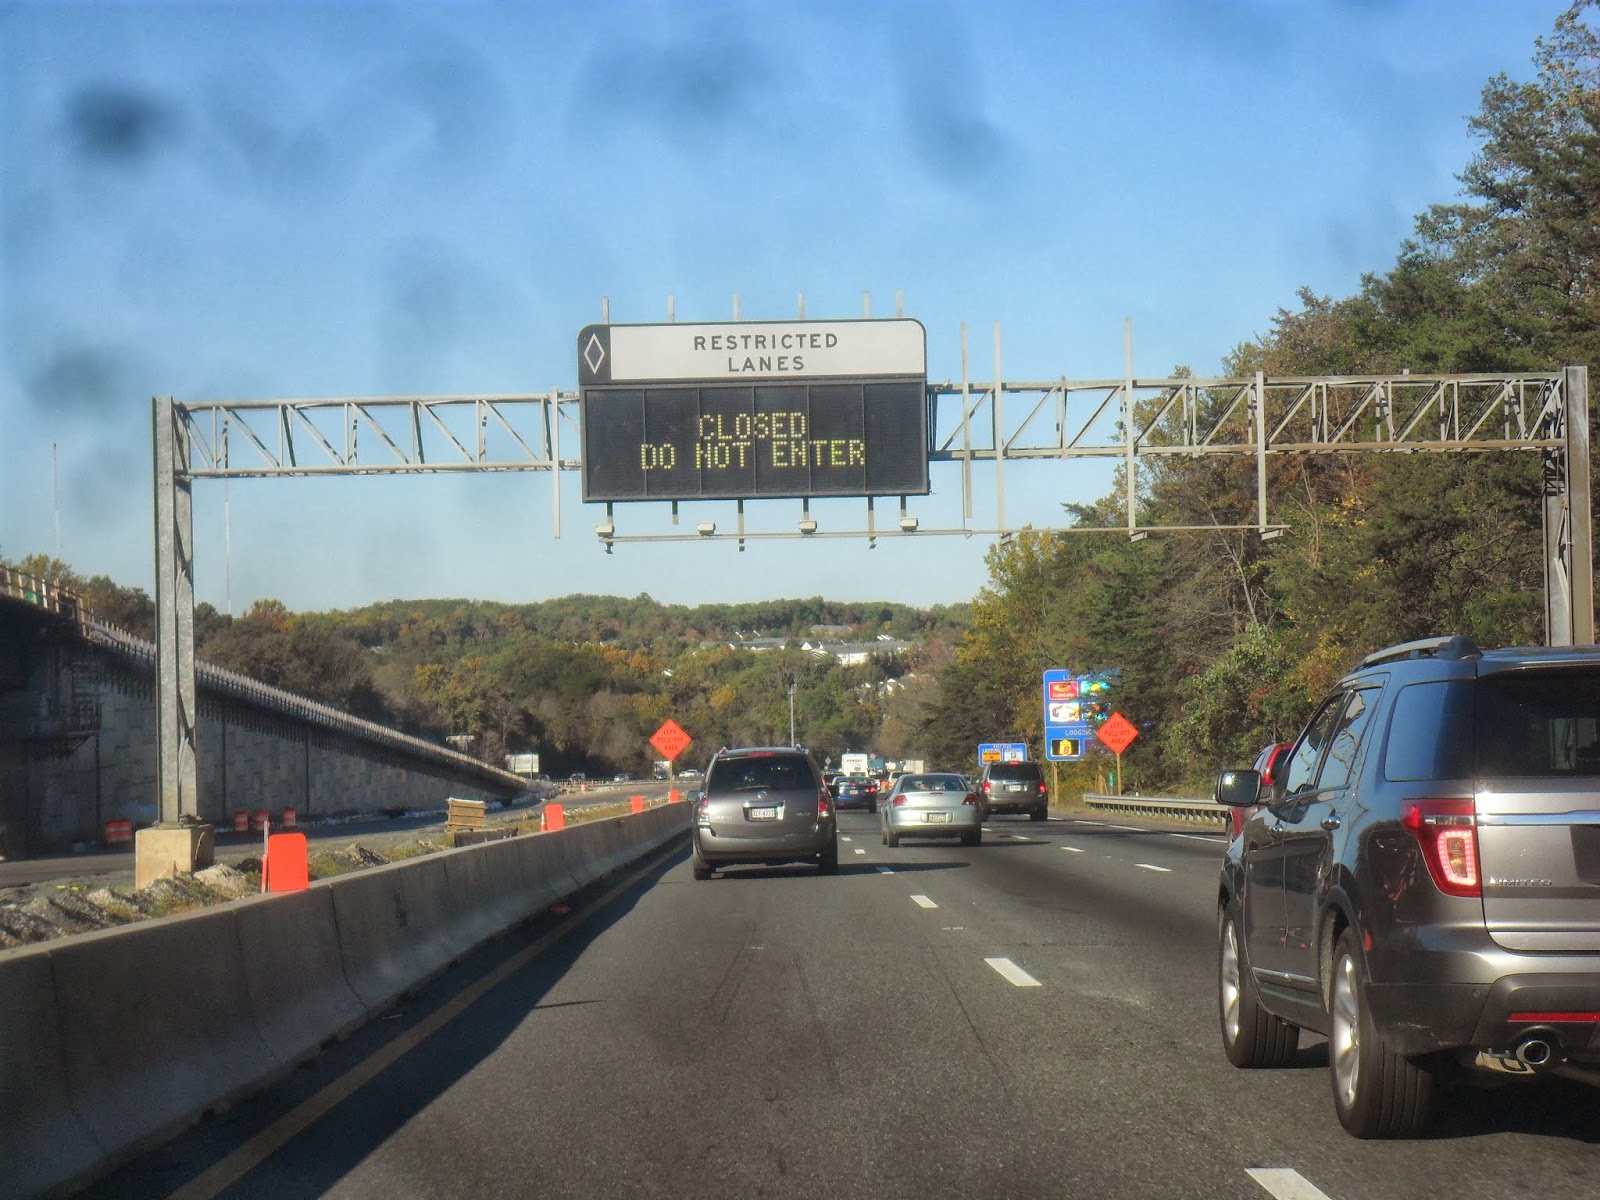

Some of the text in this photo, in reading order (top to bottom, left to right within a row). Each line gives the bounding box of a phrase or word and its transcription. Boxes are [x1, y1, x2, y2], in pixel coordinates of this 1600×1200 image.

[694, 333, 838, 351] RESTRICTED
[728, 356, 805, 372] LANES
[700, 412, 806, 440] CLOSED
[641, 439, 865, 470] DO NOT ENTER
